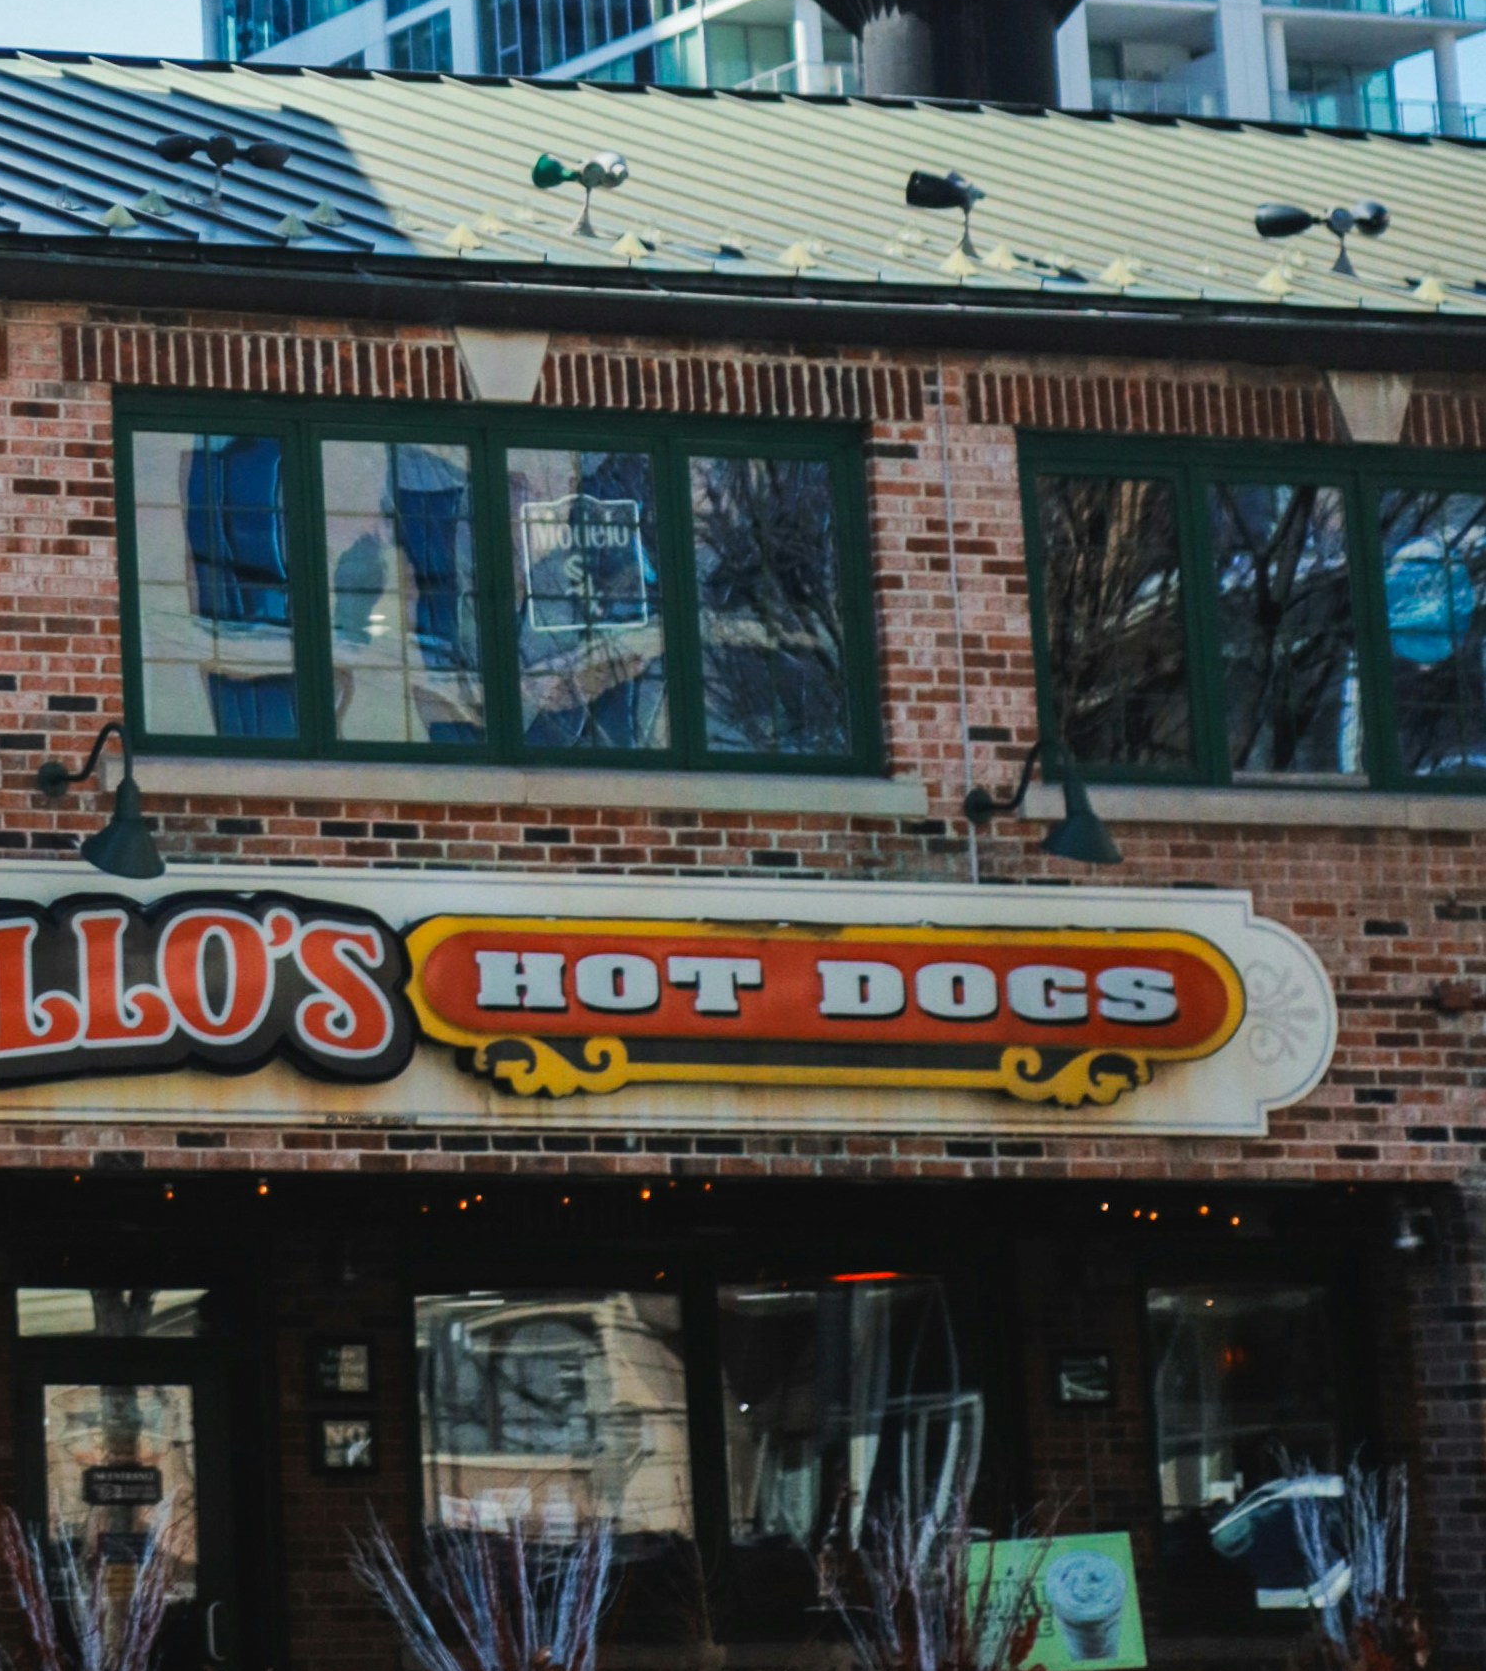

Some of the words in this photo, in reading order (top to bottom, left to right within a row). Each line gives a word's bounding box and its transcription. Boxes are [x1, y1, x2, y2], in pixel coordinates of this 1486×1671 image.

[528, 509, 630, 549] Modelo
[475, 951, 763, 1015] HOT
[816, 960, 1178, 1023] DOGS
